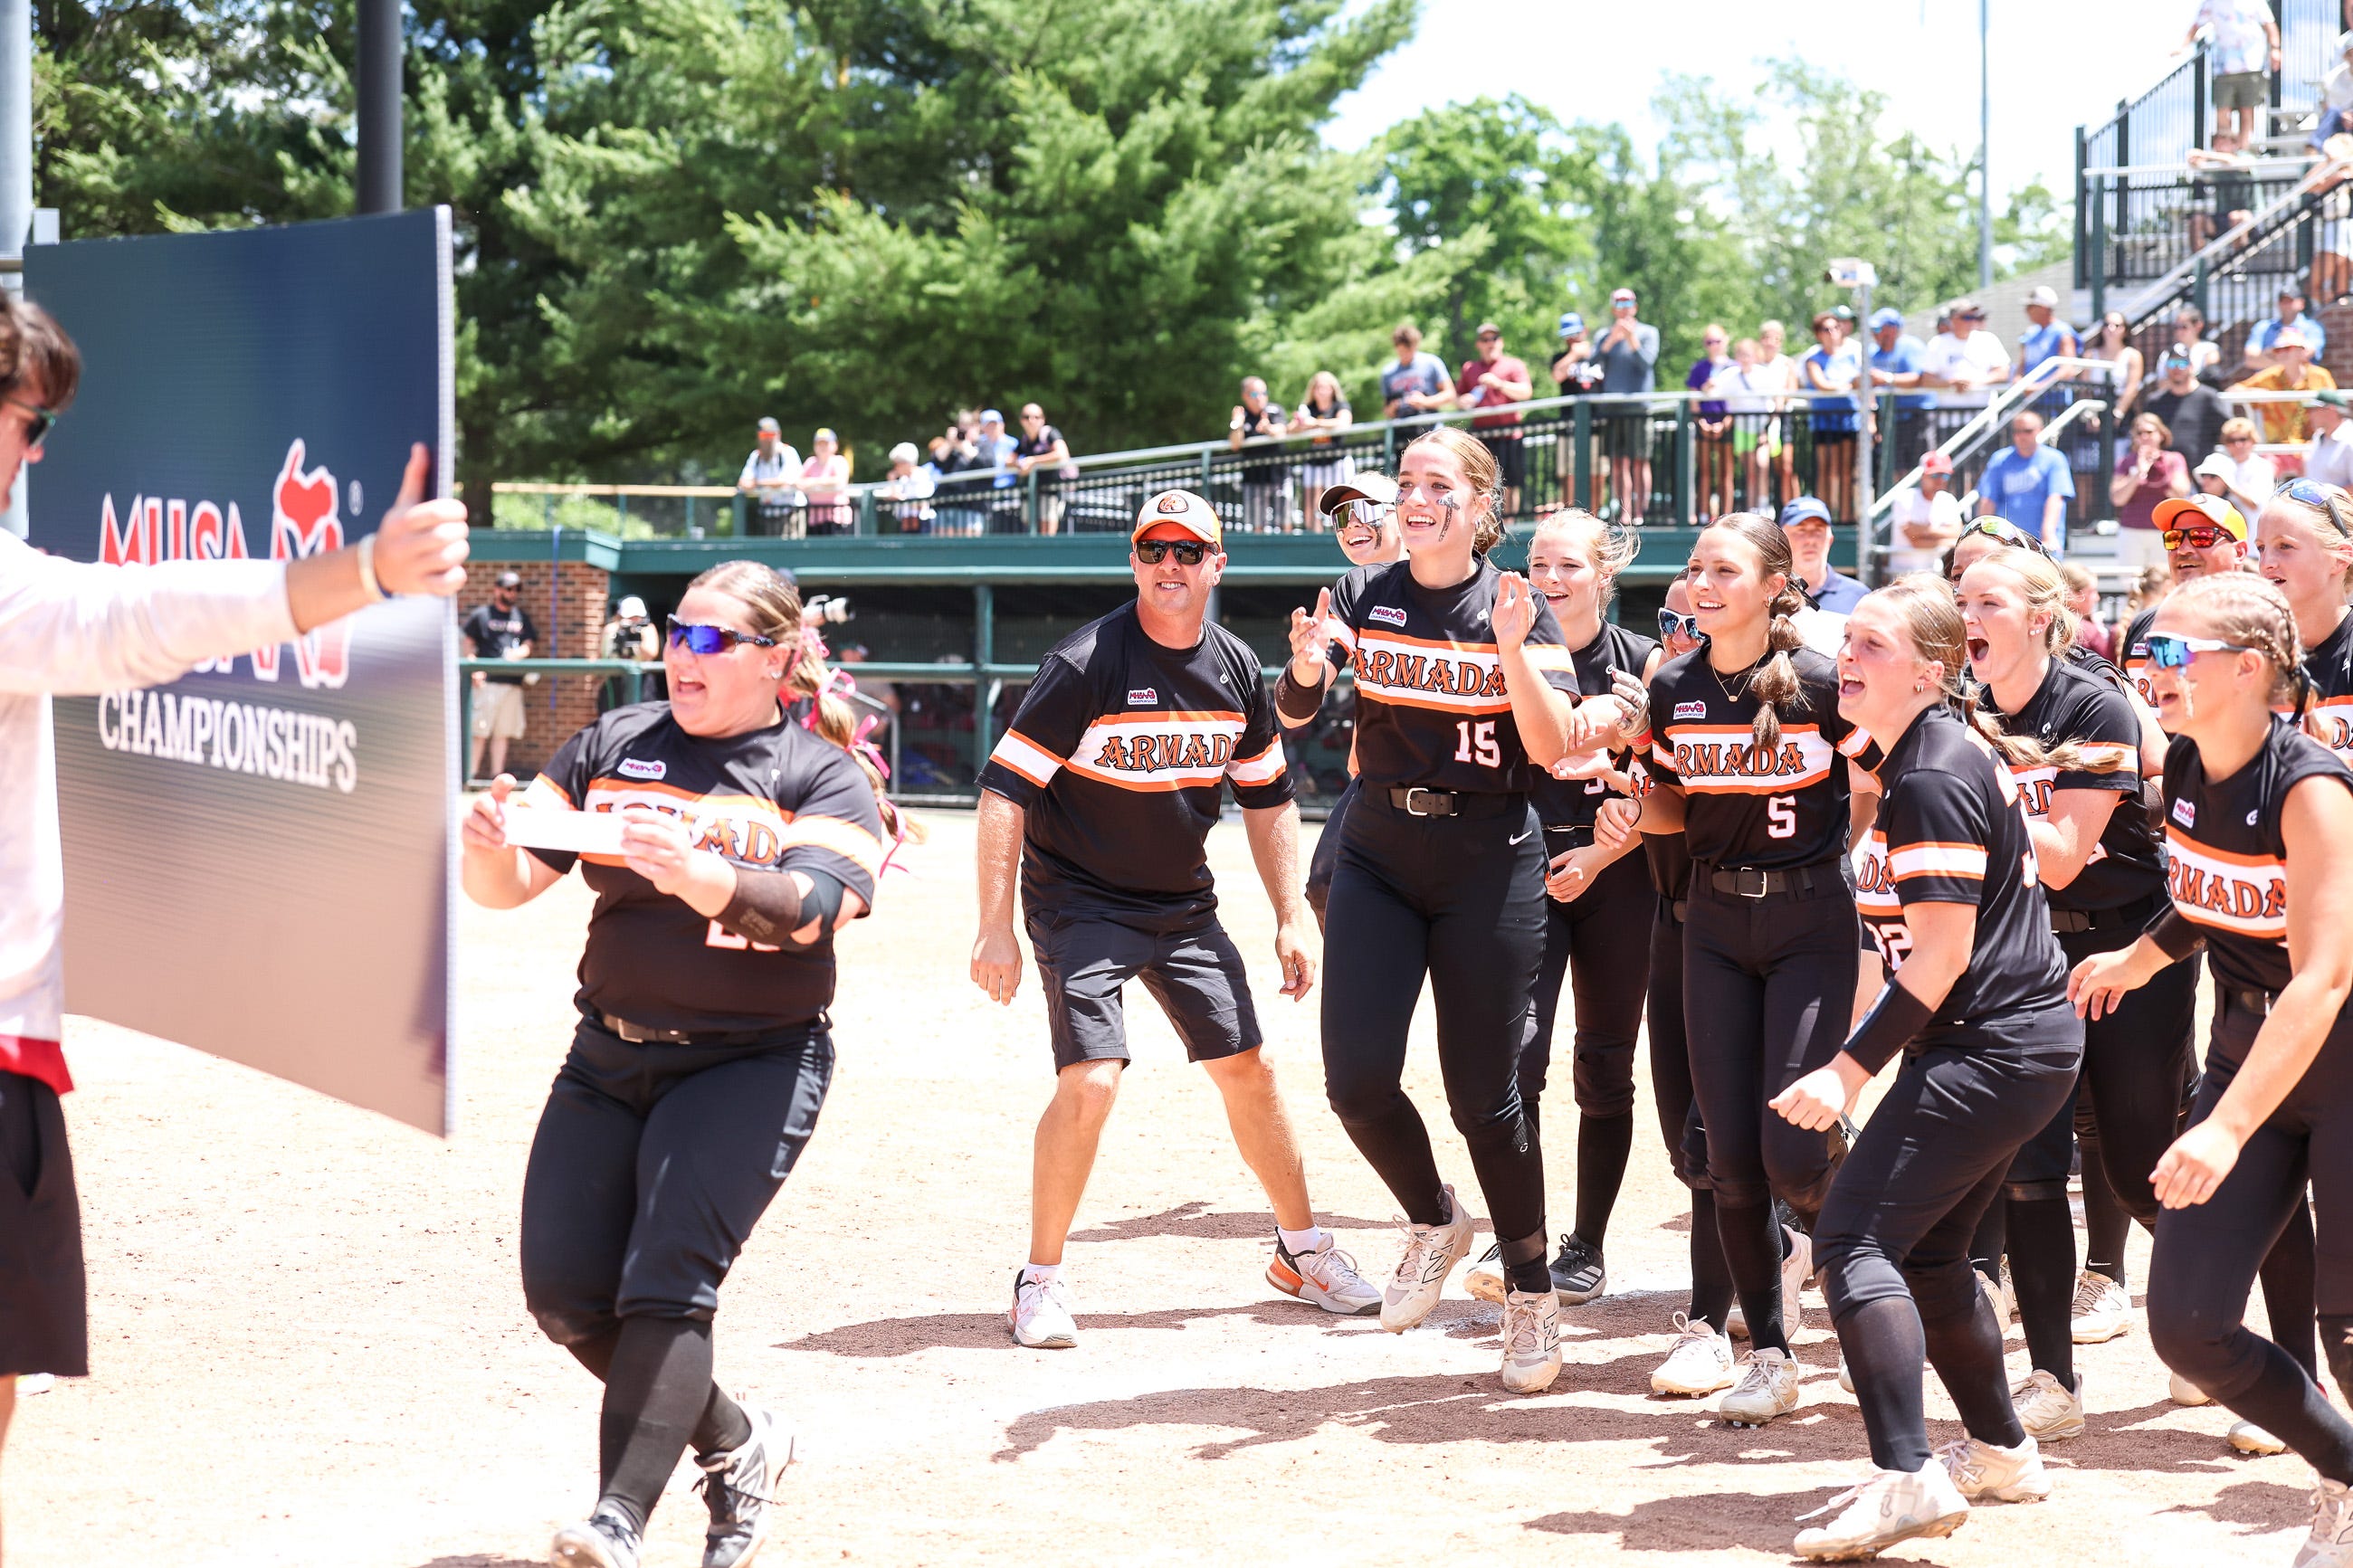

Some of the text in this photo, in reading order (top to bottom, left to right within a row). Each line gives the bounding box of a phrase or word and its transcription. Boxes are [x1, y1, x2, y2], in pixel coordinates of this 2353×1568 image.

[1354, 646, 1509, 698] ARMADA
[98, 689, 358, 794] CHAMPIONSHIPS
[1453, 719, 1501, 769] 15
[1767, 794, 1797, 840] 5
